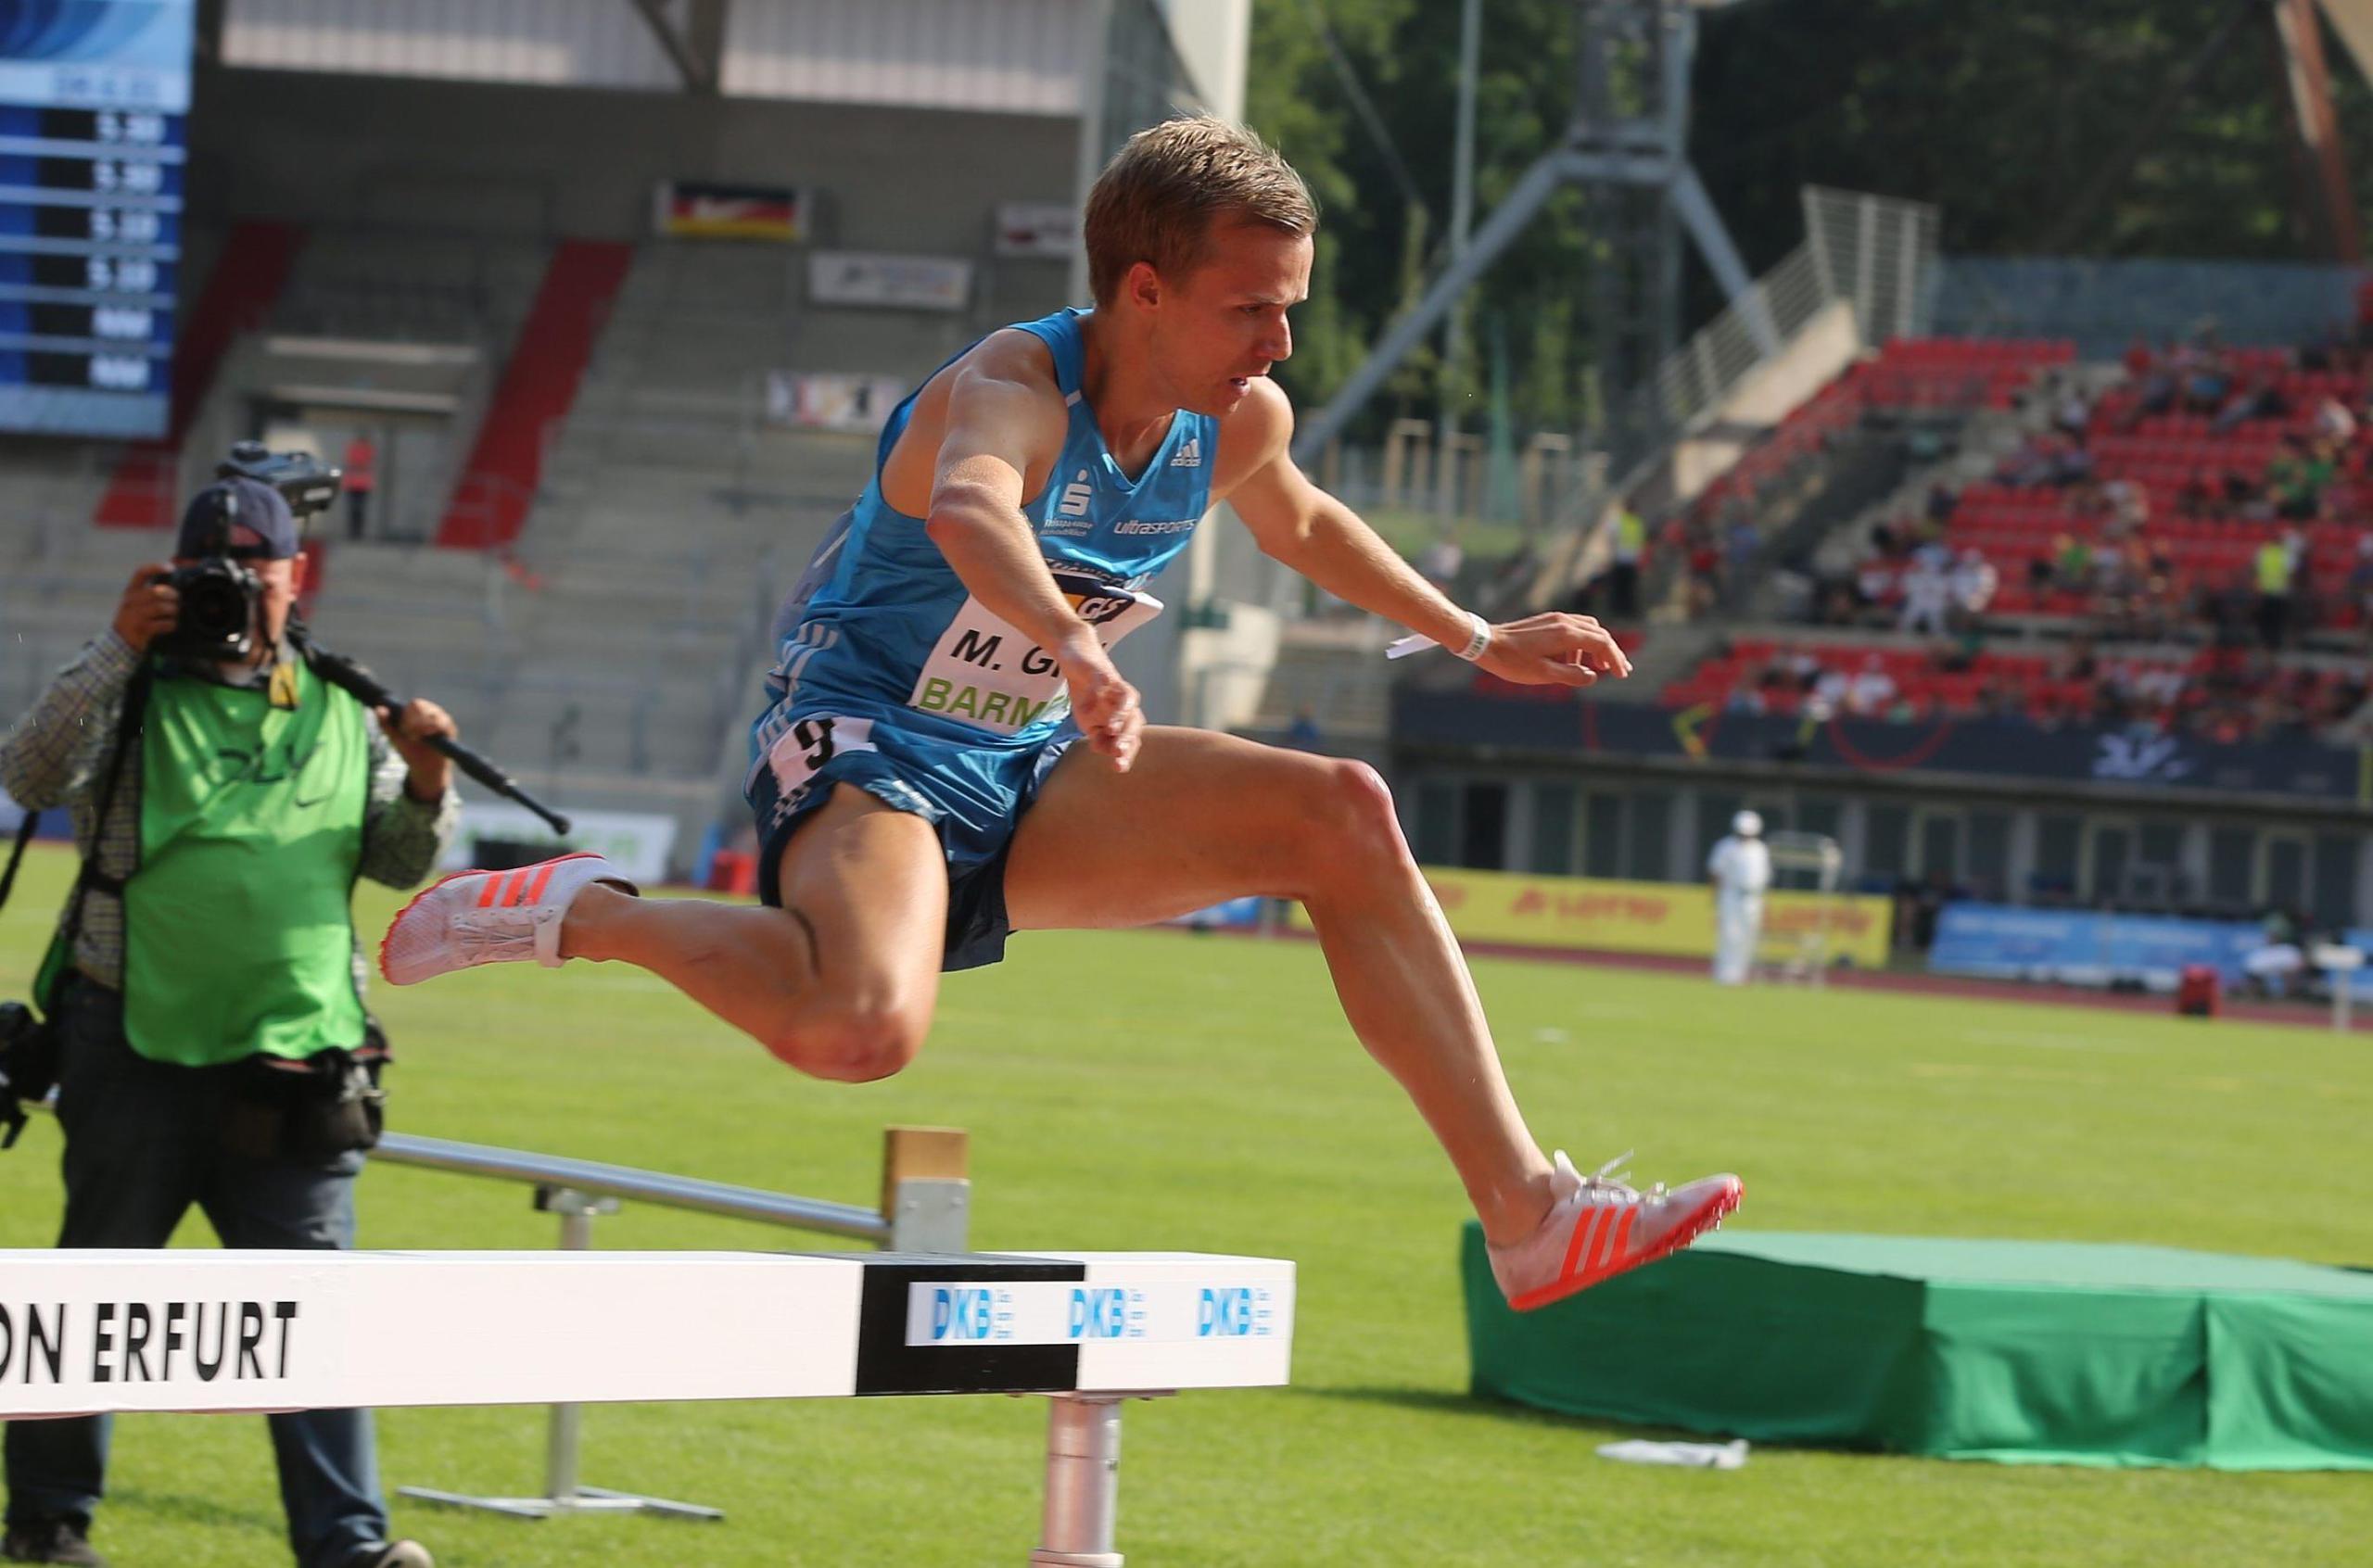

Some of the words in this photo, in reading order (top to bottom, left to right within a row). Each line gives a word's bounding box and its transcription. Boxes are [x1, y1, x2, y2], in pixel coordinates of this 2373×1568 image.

[950, 629, 1002, 671] M.
[1022, 646, 1060, 678] G
[793, 717, 835, 771] 9
[932, 1288, 991, 1340] DKB
[1069, 1288, 1125, 1338] DKB
[1198, 1287, 1251, 1336] DKB
[90, 1300, 300, 1383] ERFURT
